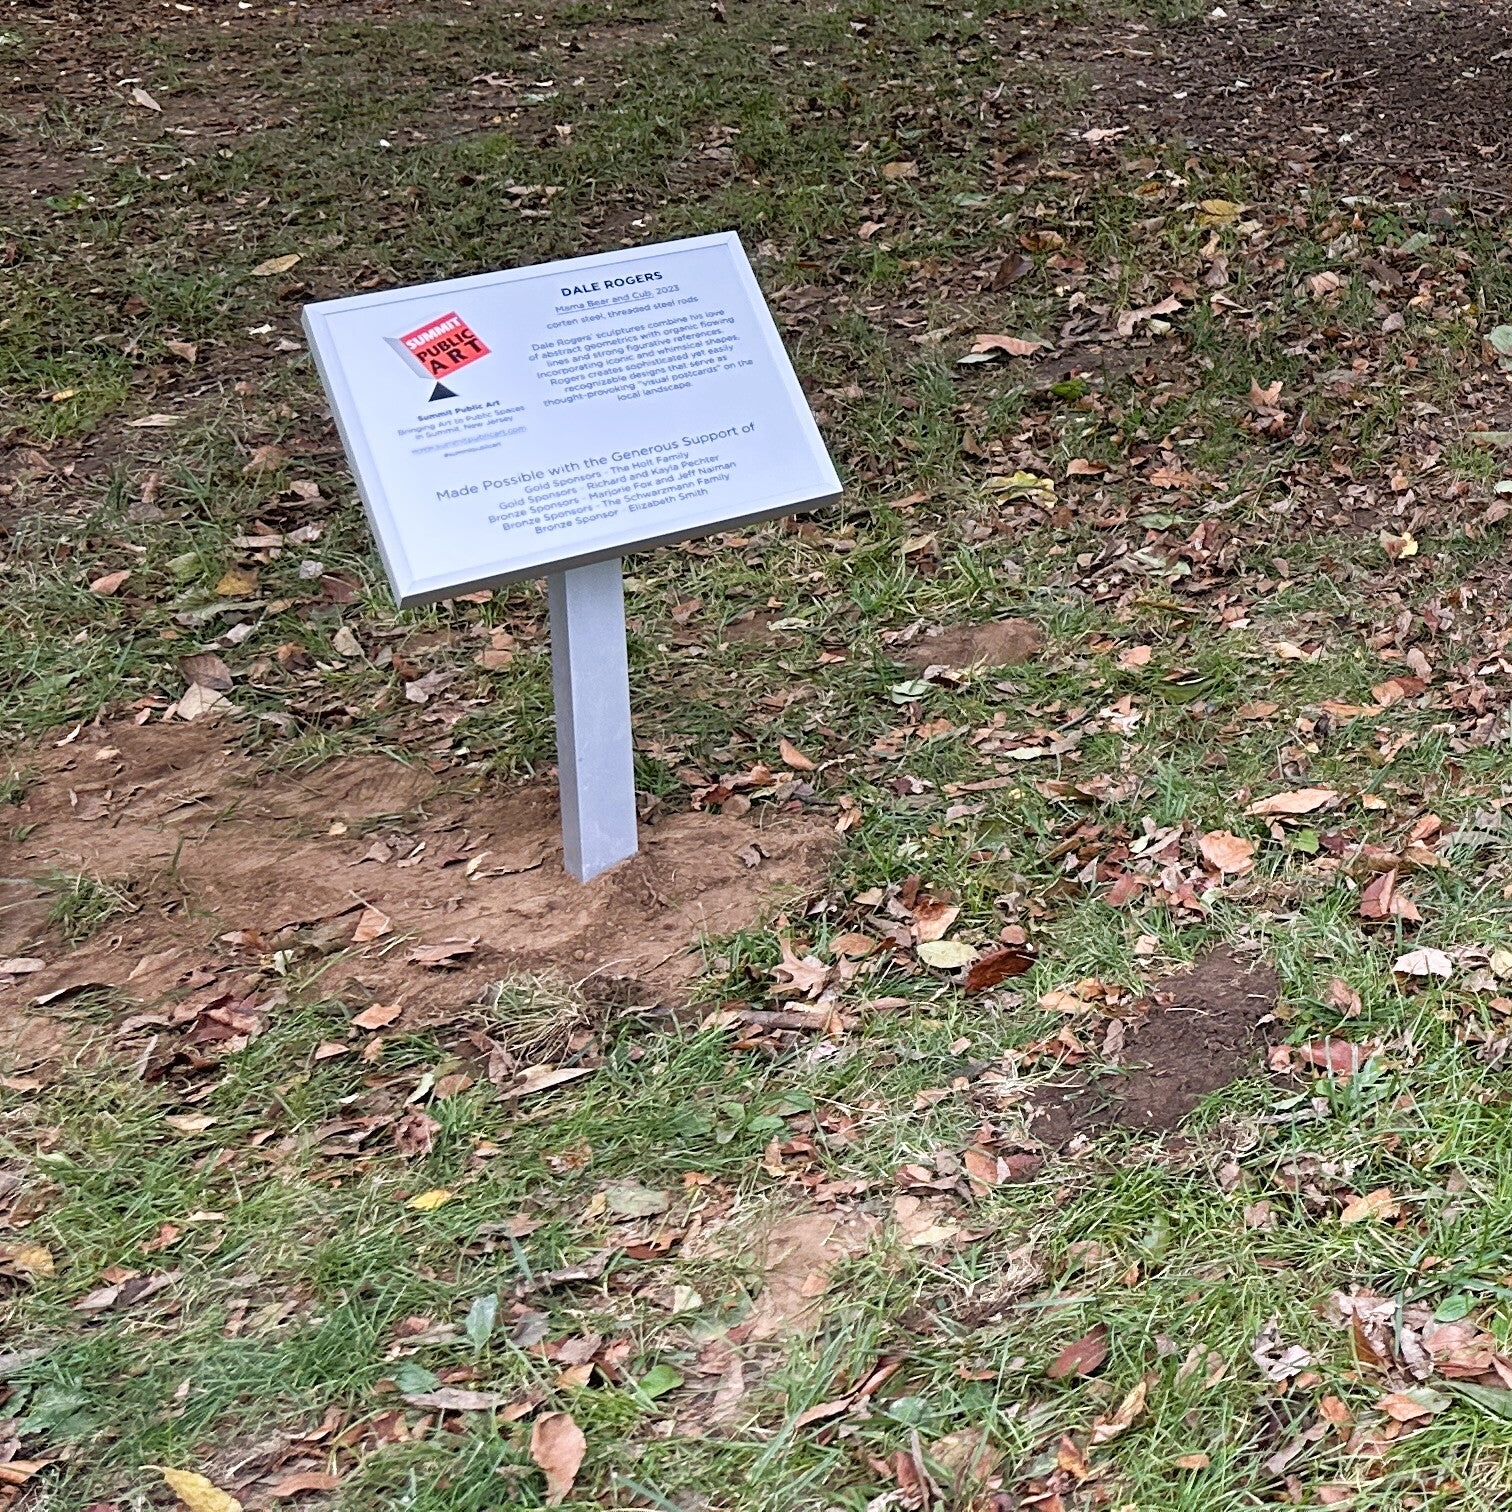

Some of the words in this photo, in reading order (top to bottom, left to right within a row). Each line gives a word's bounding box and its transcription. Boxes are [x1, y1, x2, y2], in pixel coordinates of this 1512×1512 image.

[555, 303, 585, 313] Mama
[587, 299, 609, 307] Bear
[612, 294, 630, 302] and
[655, 284, 680, 295] 2023
[561, 282, 601, 296] DALE
[604, 272, 663, 289] ROGERS
[547, 319, 578, 329] corten
[607, 304, 651, 318] threaded
[653, 299, 675, 309] steel
[677, 296, 699, 305] rods
[405, 317, 463, 350] SUMMIT
[416, 328, 476, 363] PUBLIC
[529, 353, 538, 361] of
[542, 346, 582, 359] abstract
[584, 336, 635, 351] geometrics
[640, 331, 661, 339] with
[663, 324, 698, 335] organic
[700, 317, 735, 328] flowing
[531, 342, 554, 351] Dale
[596, 325, 645, 339] sculptures
[648, 317, 688, 329] combine
[433, 338, 482, 375] ART
[546, 359, 569, 367] lines
[573, 353, 590, 362] and
[593, 348, 624, 358] strong
[626, 338, 671, 351] figurative
[550, 375, 585, 386] Rogers
[588, 367, 623, 378] creates
[625, 352, 689, 371] sophisticated
[692, 350, 705, 359] yet
[708, 345, 733, 354] easily
[606, 355, 634, 365] iconic
[637, 350, 655, 359] and
[657, 341, 703, 354] whimsical
[564, 376, 627, 392] recognizable
[629, 368, 666, 379] designs
[668, 363, 687, 372] that
[690, 358, 714, 367] serve
[543, 383, 636, 407] thought-provoking
[617, 390, 641, 401] local
[417, 410, 453, 422] Summit
[454, 404, 483, 414] Public
[465, 413, 492, 421] Public
[494, 406, 525, 416] Spaces
[487, 416, 513, 425] Jersey
[436, 485, 478, 501] Made
[482, 471, 544, 490] Possible
[548, 462, 580, 475] with
[583, 457, 607, 468] the
[611, 441, 679, 462] Generous
[682, 427, 739, 446] Support
[742, 422, 754, 433] of
[524, 482, 550, 494] Gold
[553, 472, 602, 487] Sponsors
[610, 466, 630, 474] The
[632, 459, 654, 469] Holt
[656, 452, 689, 464] Family
[488, 510, 526, 524] Bronze
[529, 498, 579, 513] Sponsors
[588, 486, 631, 500] Marjorie
[633, 481, 653, 489] Fox
[656, 475, 674, 485] and
[678, 469, 695, 480] Jeff
[499, 498, 525, 510] Gold
[527, 487, 578, 503] Sponsors
[586, 475, 627, 490] Richard
[630, 470, 649, 480] and
[651, 465, 679, 475] Kayla
[681, 455, 719, 468] Pechter
[502, 517, 540, 531] Bronze
[543, 505, 593, 521] Sponsors
[601, 499, 621, 507] The
[624, 482, 695, 502] Schwarzmann
[697, 474, 729, 485] Family
[535, 521, 573, 534] Bronze
[575, 510, 618, 525] Sponsor
[628, 496, 676, 512] Elizabeth
[678, 488, 708, 501] Smith
